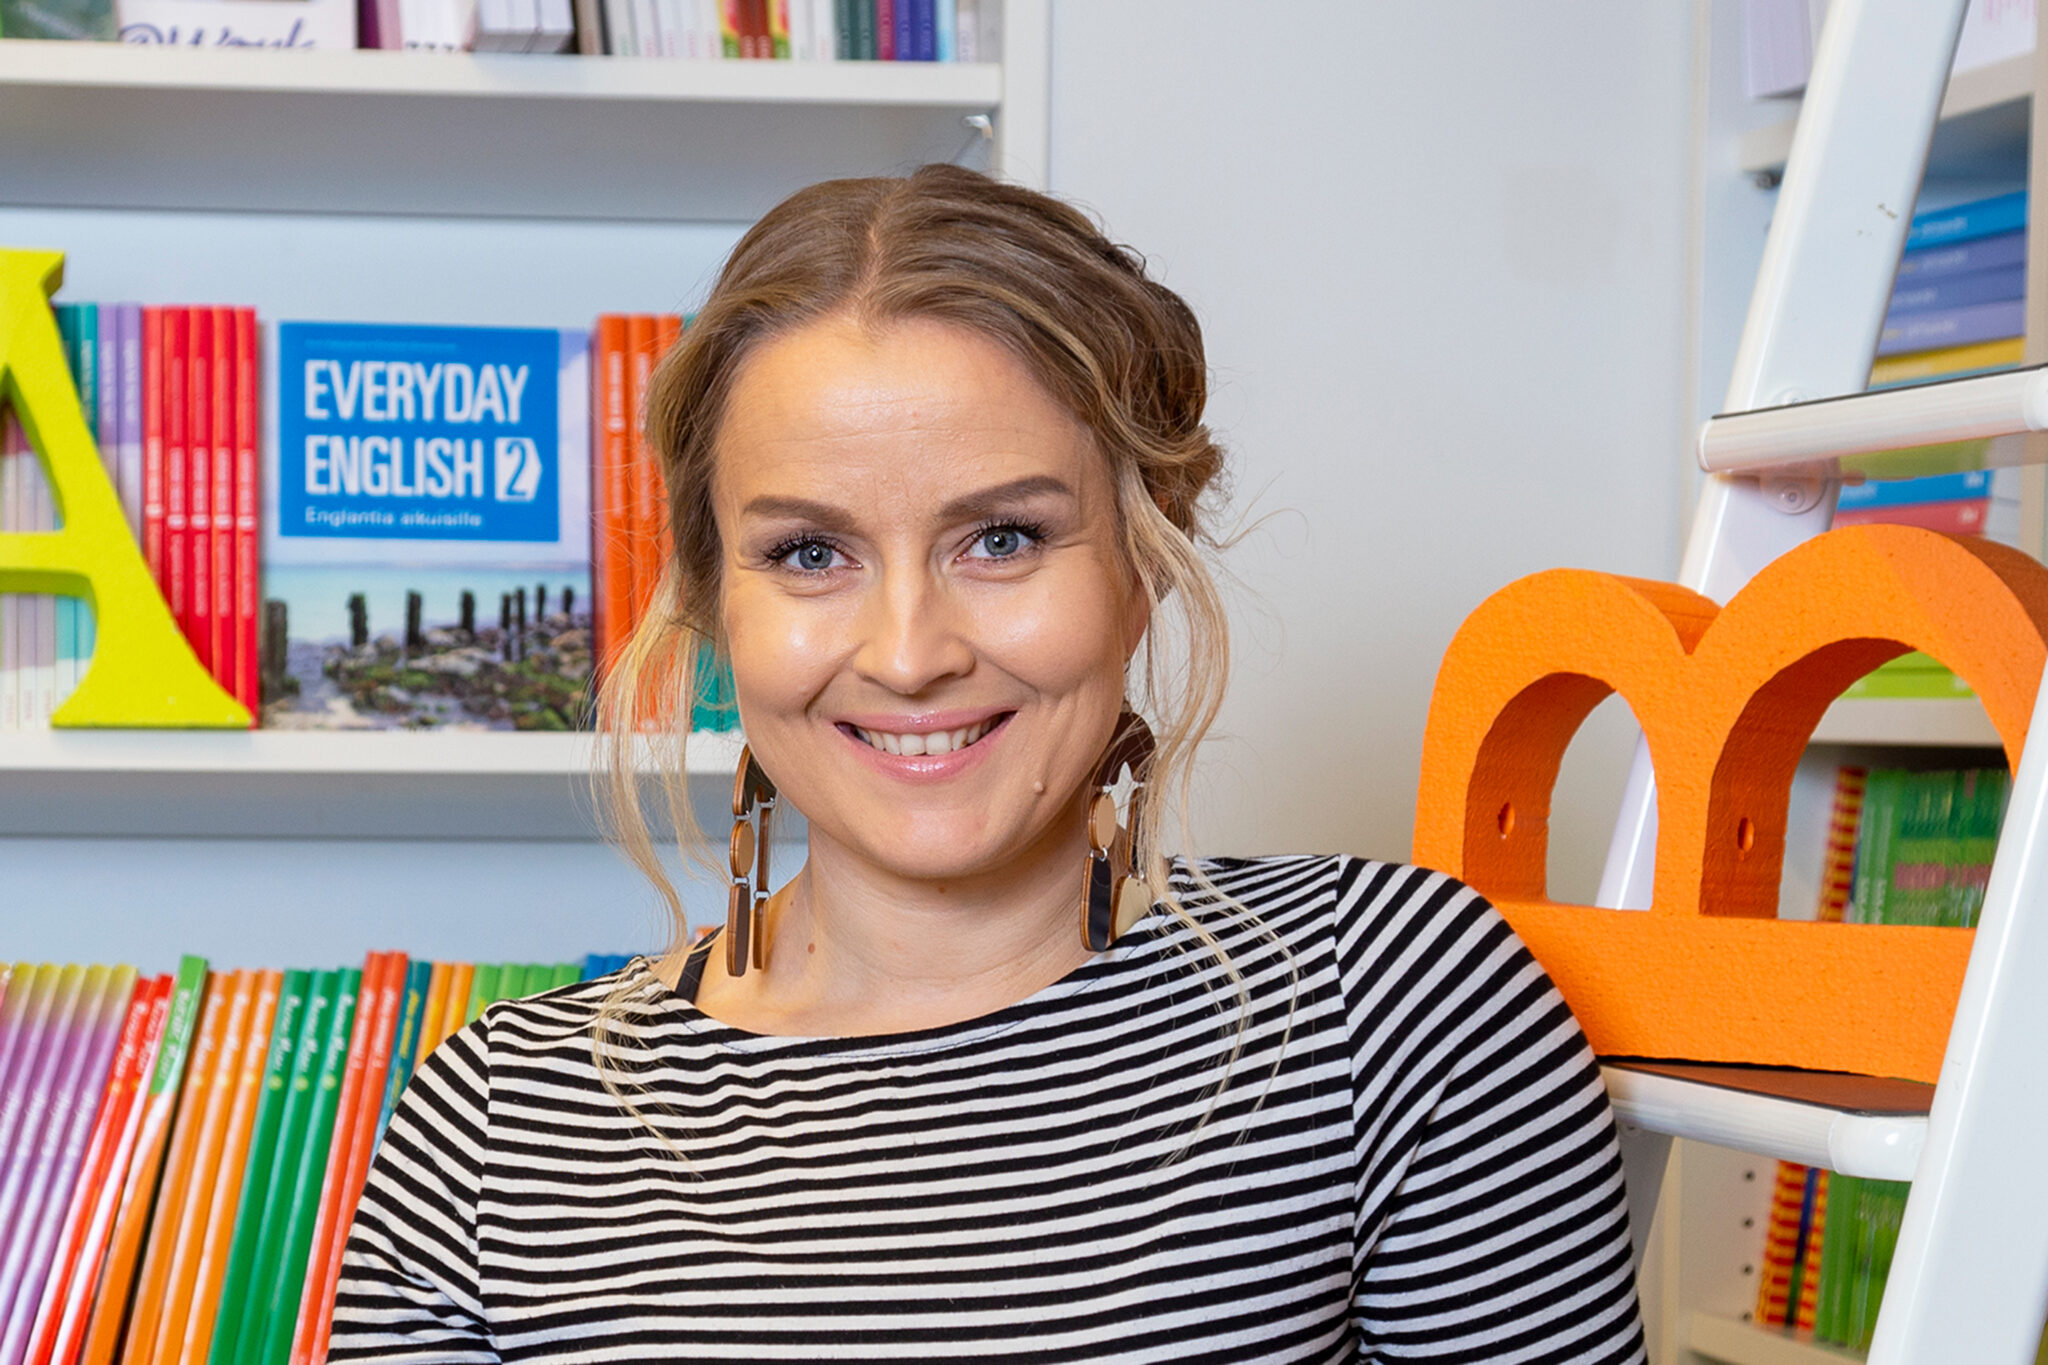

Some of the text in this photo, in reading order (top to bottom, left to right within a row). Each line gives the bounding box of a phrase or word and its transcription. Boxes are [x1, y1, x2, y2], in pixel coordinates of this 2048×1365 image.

[304, 359, 529, 424] EVERYDAY
[304, 434, 530, 498] ENGLISH 2
